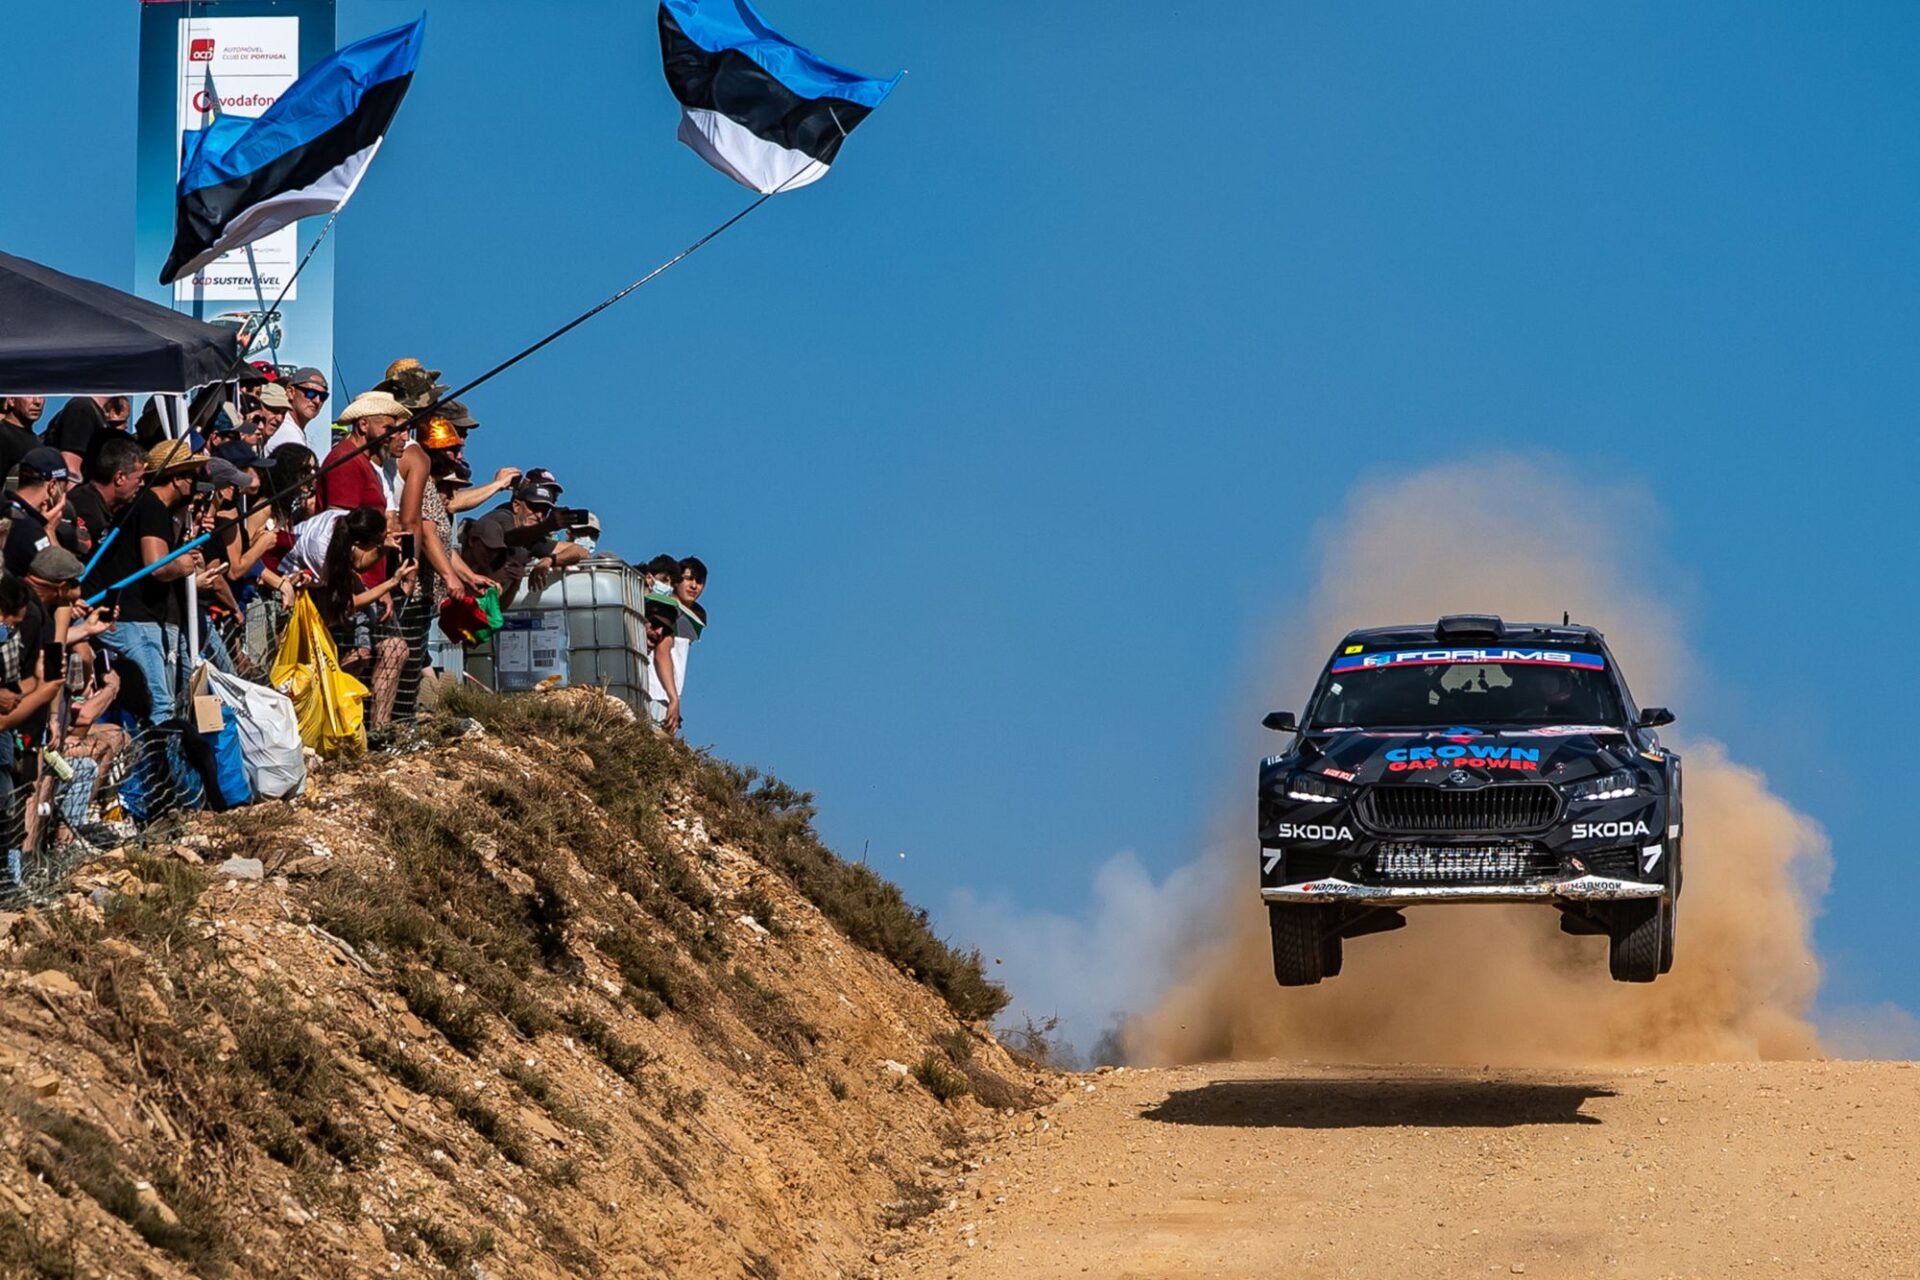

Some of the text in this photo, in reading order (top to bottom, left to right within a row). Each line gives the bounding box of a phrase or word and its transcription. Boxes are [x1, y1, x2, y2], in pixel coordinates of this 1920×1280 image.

[219, 94, 276, 106] vodafon
[213, 274, 281, 286] SUSTENÁVEL
[1396, 650, 1571, 662] FORUM8
[1385, 745, 1540, 762] CROWN
[1388, 758, 1537, 771] GAS POWER
[1262, 847, 1282, 875] 7
[1642, 844, 1662, 874] 7
[1312, 883, 1358, 893] Hanko
